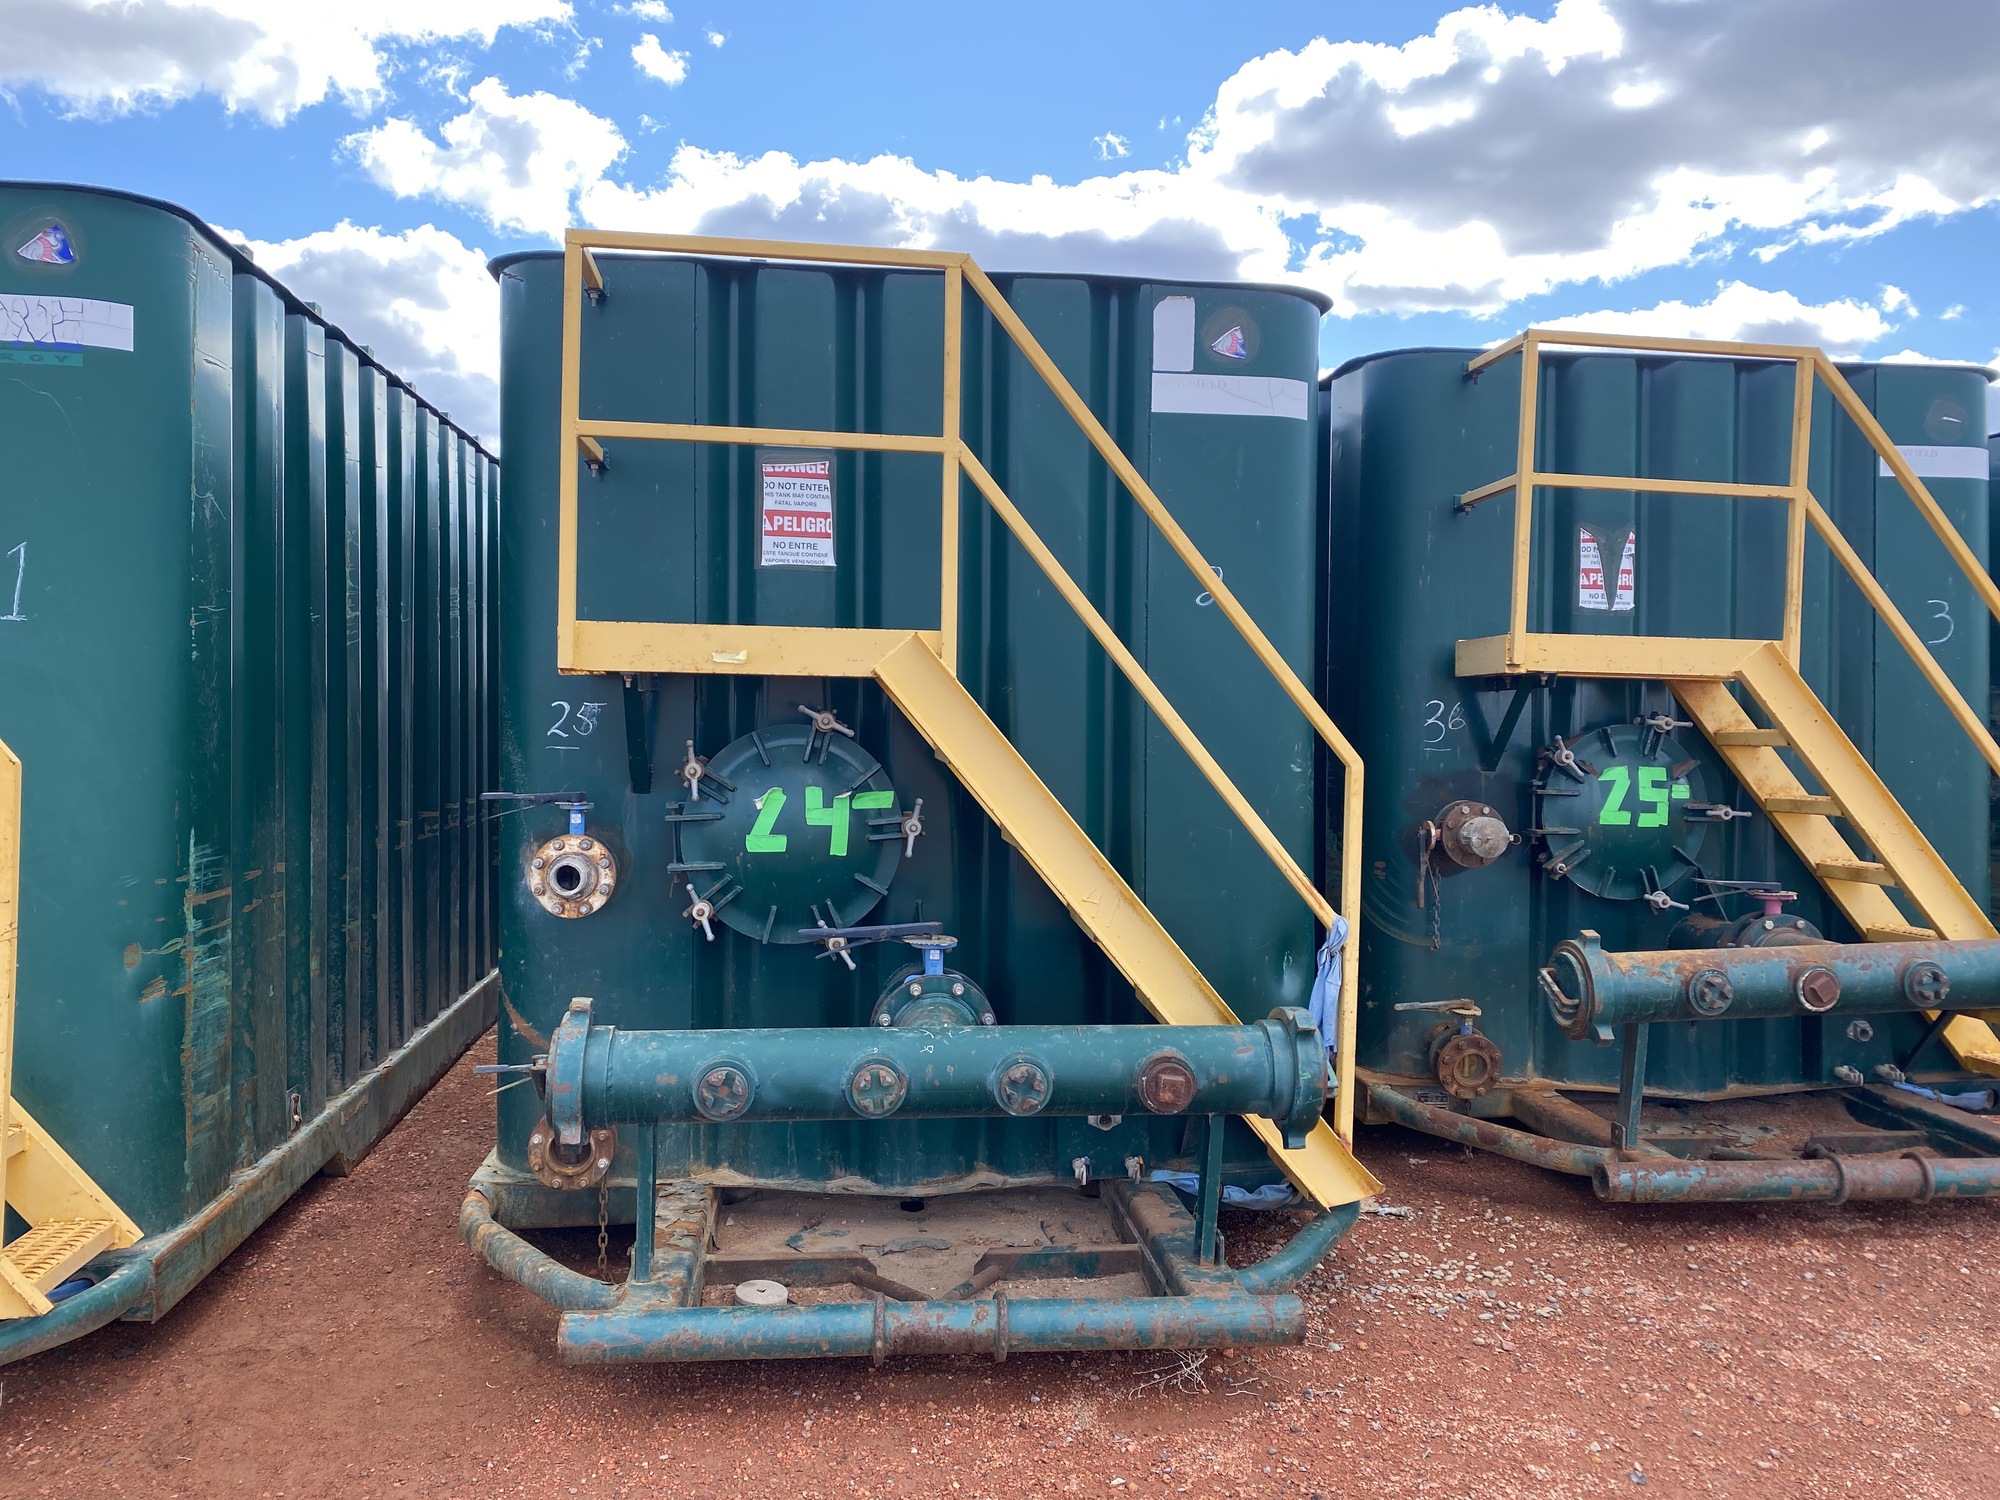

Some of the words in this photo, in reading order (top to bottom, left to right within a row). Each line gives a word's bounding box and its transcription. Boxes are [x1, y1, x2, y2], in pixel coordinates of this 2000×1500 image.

[774, 462, 829, 475] DANGE
[777, 482, 797, 491] NOT
[799, 483, 829, 492] ENTER
[772, 541, 787, 549] NO
[788, 541, 818, 550] ENTRE
[0, 541, 28, 622] 1
[1926, 599, 1955, 645] 3
[1423, 699, 1466, 743] 36
